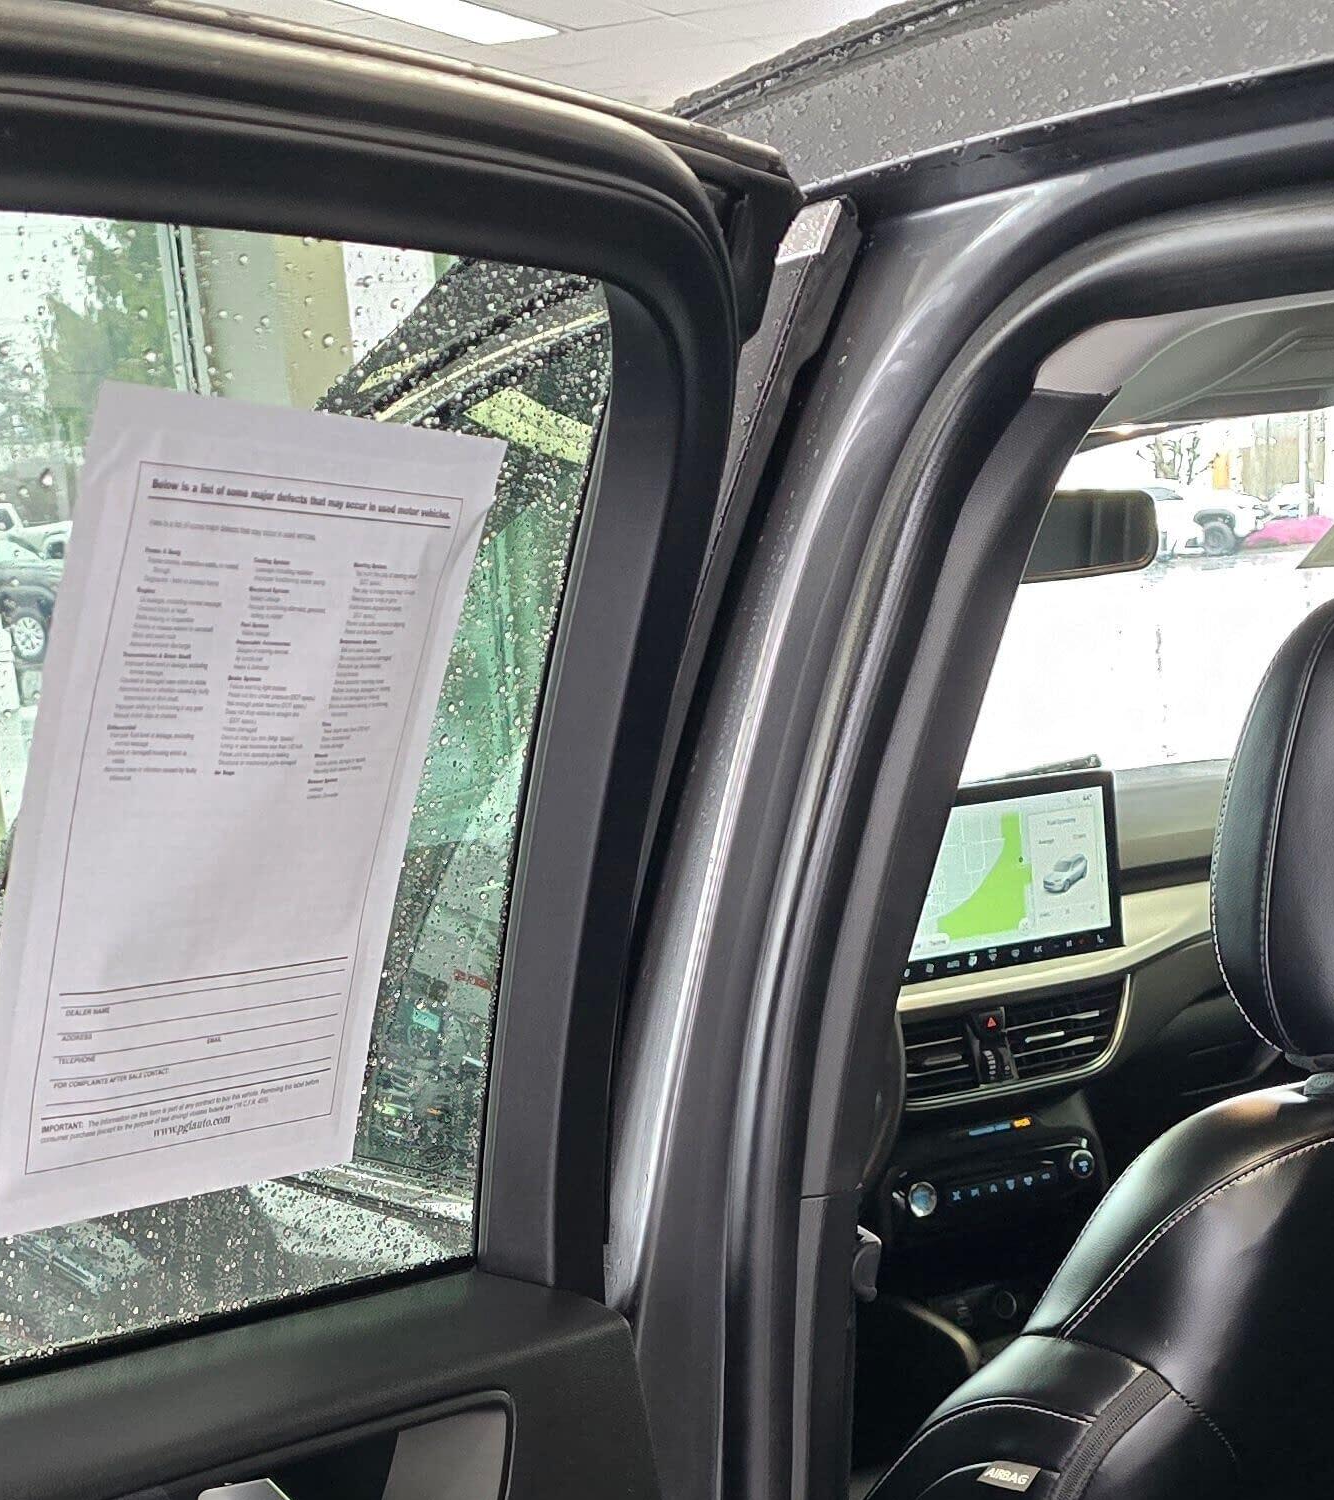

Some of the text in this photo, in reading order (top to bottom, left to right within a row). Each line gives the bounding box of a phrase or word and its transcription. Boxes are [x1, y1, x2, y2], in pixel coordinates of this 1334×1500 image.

[152, 478, 179, 490] Below
[181, 480, 189, 491] is
[192, 484, 197, 492] a
[201, 482, 213, 494] list
[216, 486, 225, 495] of
[227, 488, 248, 498] some
[251, 490, 275, 501] major
[277, 490, 307, 504] defects
[310, 496, 325, 506] that
[328, 500, 343, 509] may
[346, 500, 367, 510] occur
[369, 502, 376, 512] in
[378, 504, 396, 514] used
[397, 506, 419, 516] motor
[65, 1006, 111, 1016] DEALER NAME
[61, 1033, 93, 1042] ADDRESS
[58, 1055, 96, 1065] TELEPHONE
[53, 1081, 67, 1089] FOR
[69, 1078, 109, 1088] COMPLAINTS
[110, 1075, 127, 1084] AFTER
[129, 1072, 142, 1082] SALE
[983, 1467, 1030, 1485] AIRBAG
